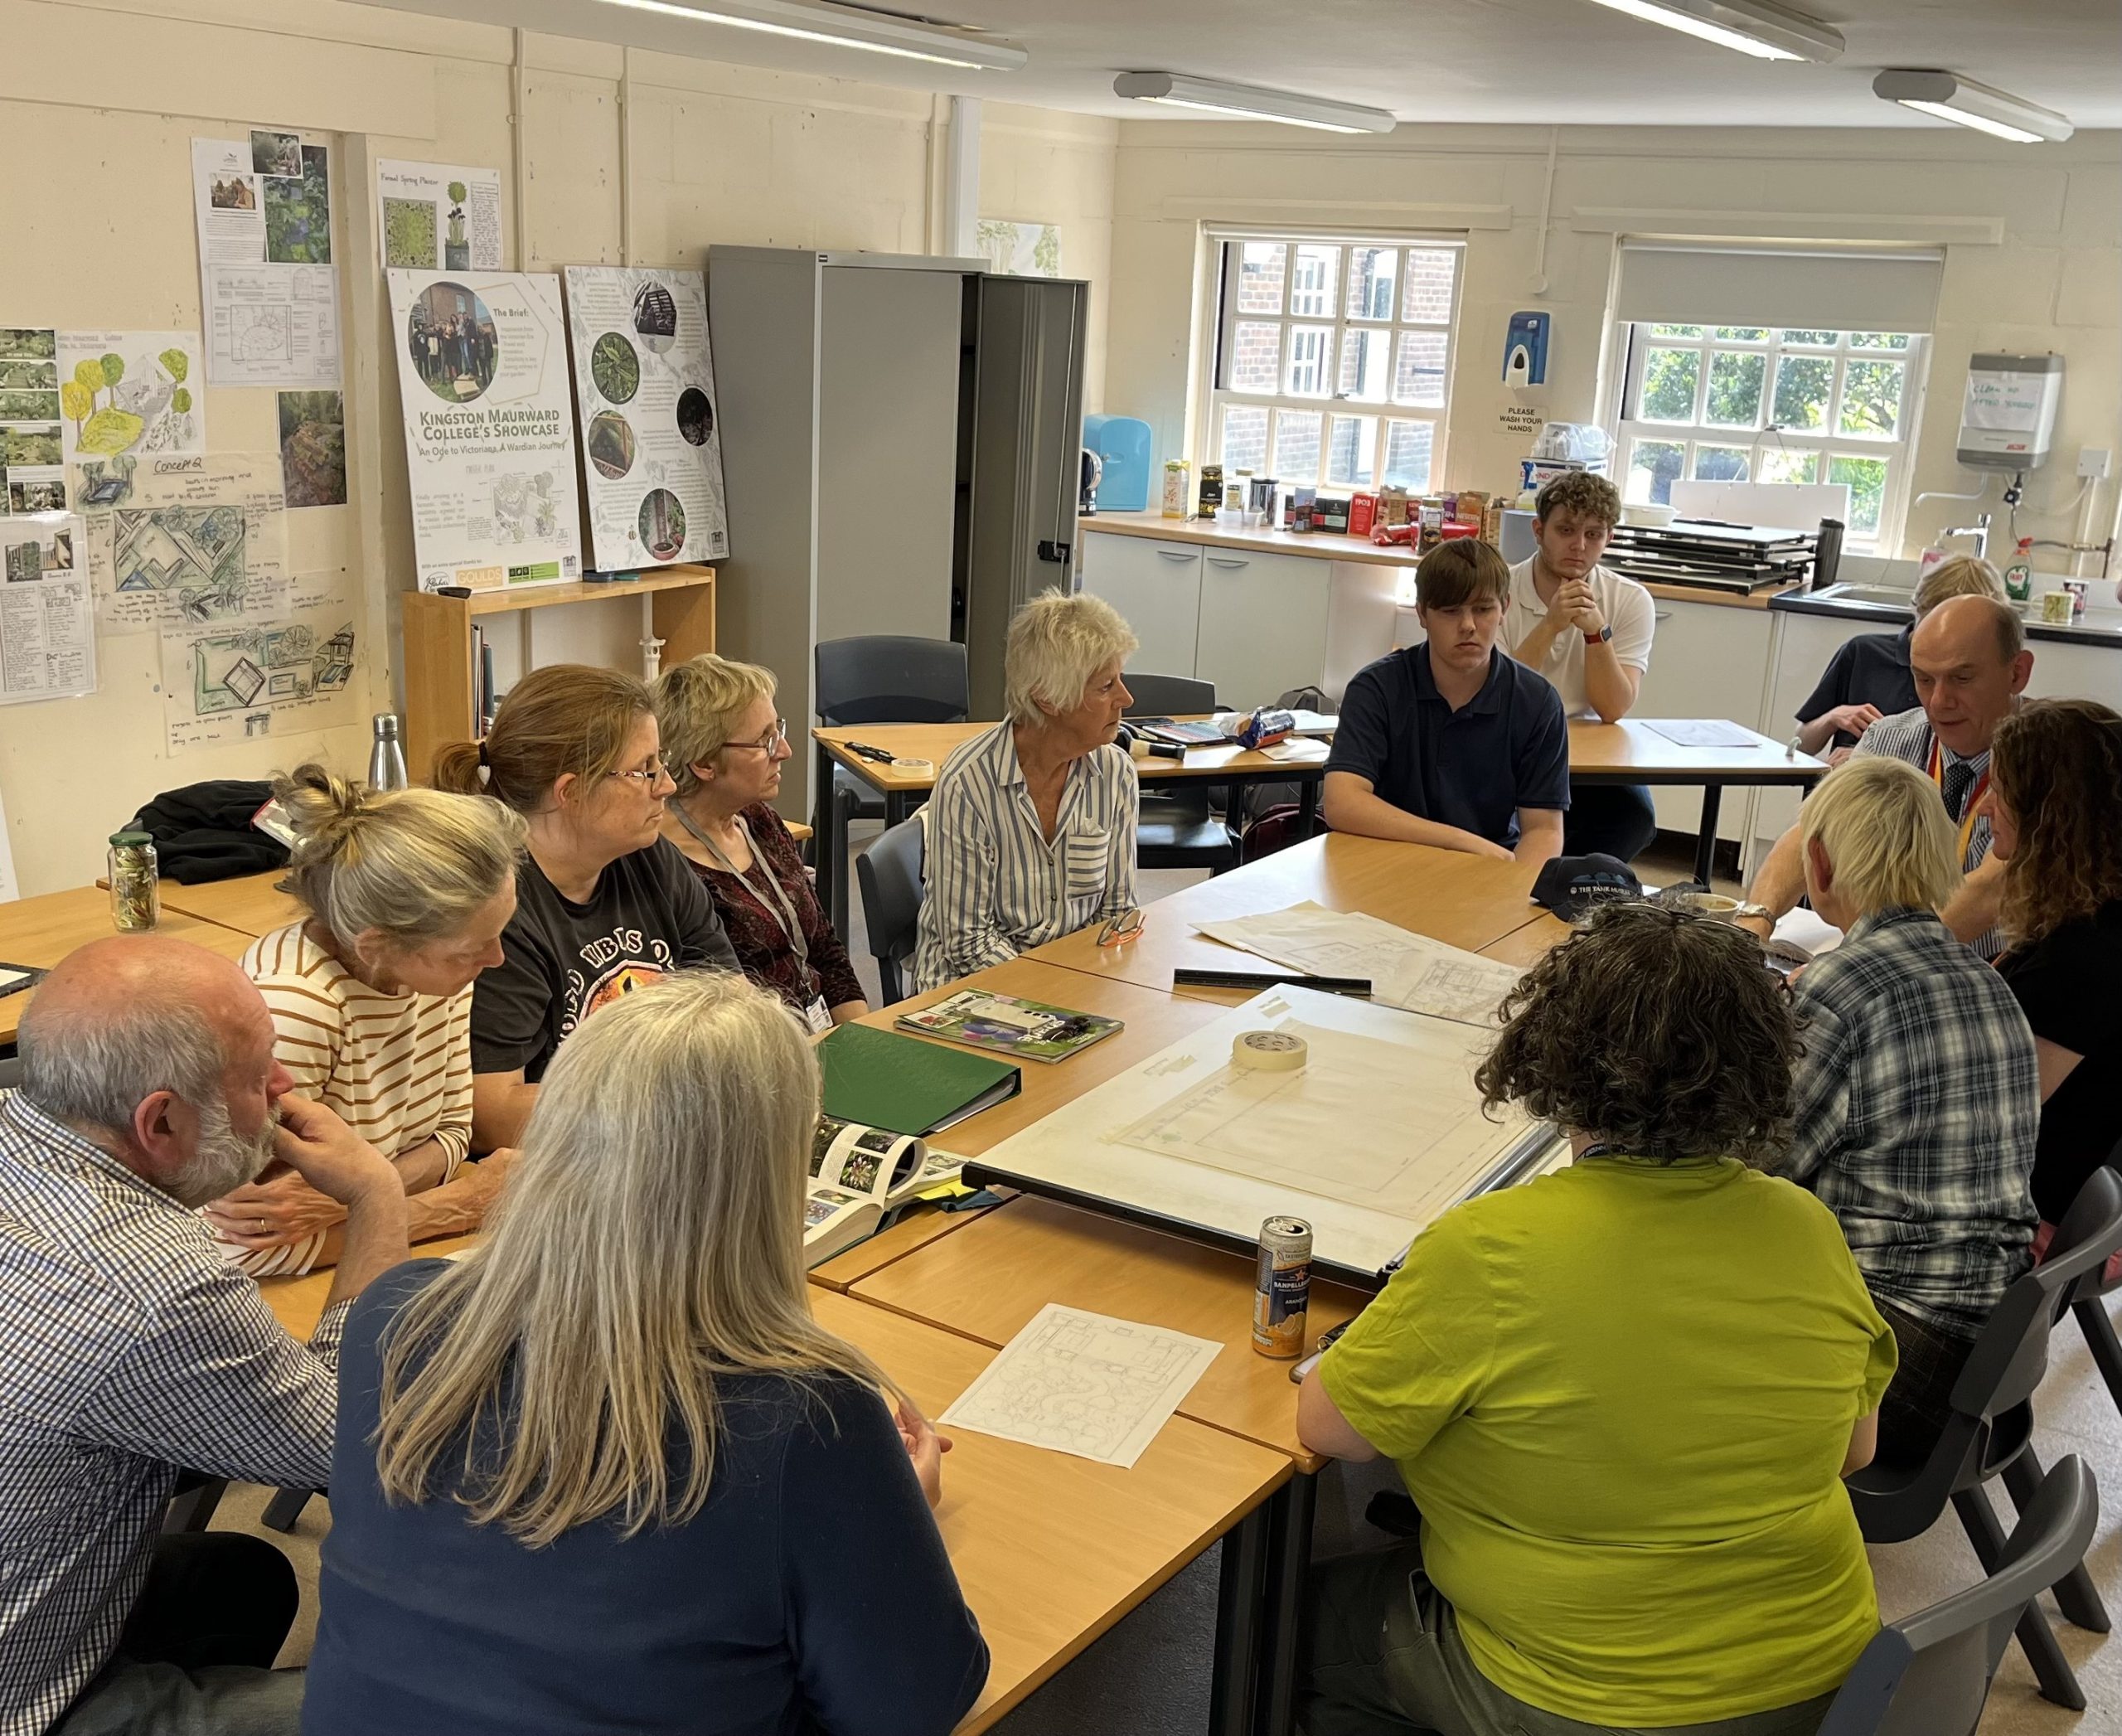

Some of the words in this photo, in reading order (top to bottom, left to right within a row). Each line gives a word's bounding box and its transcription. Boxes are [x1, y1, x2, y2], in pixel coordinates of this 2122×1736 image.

[493, 308, 506, 317] The
[508, 308, 529, 317] Brief:
[419, 410, 485, 426] KINGSTON
[487, 409, 560, 424] MAURWARD
[1509, 407, 1535, 415] PLEASE
[423, 424, 491, 441] COLLEGE'S
[494, 424, 560, 438] SHOWCASE
[419, 448, 430, 456] An
[432, 446, 449, 456] Ode
[450, 445, 459, 454] to
[506, 441, 537, 452] Wardian
[538, 441, 566, 452] Journey
[154, 458, 191, 473] Concept
[1354, 498, 1371, 507] 1903
[458, 568, 501, 584] GOULDS
